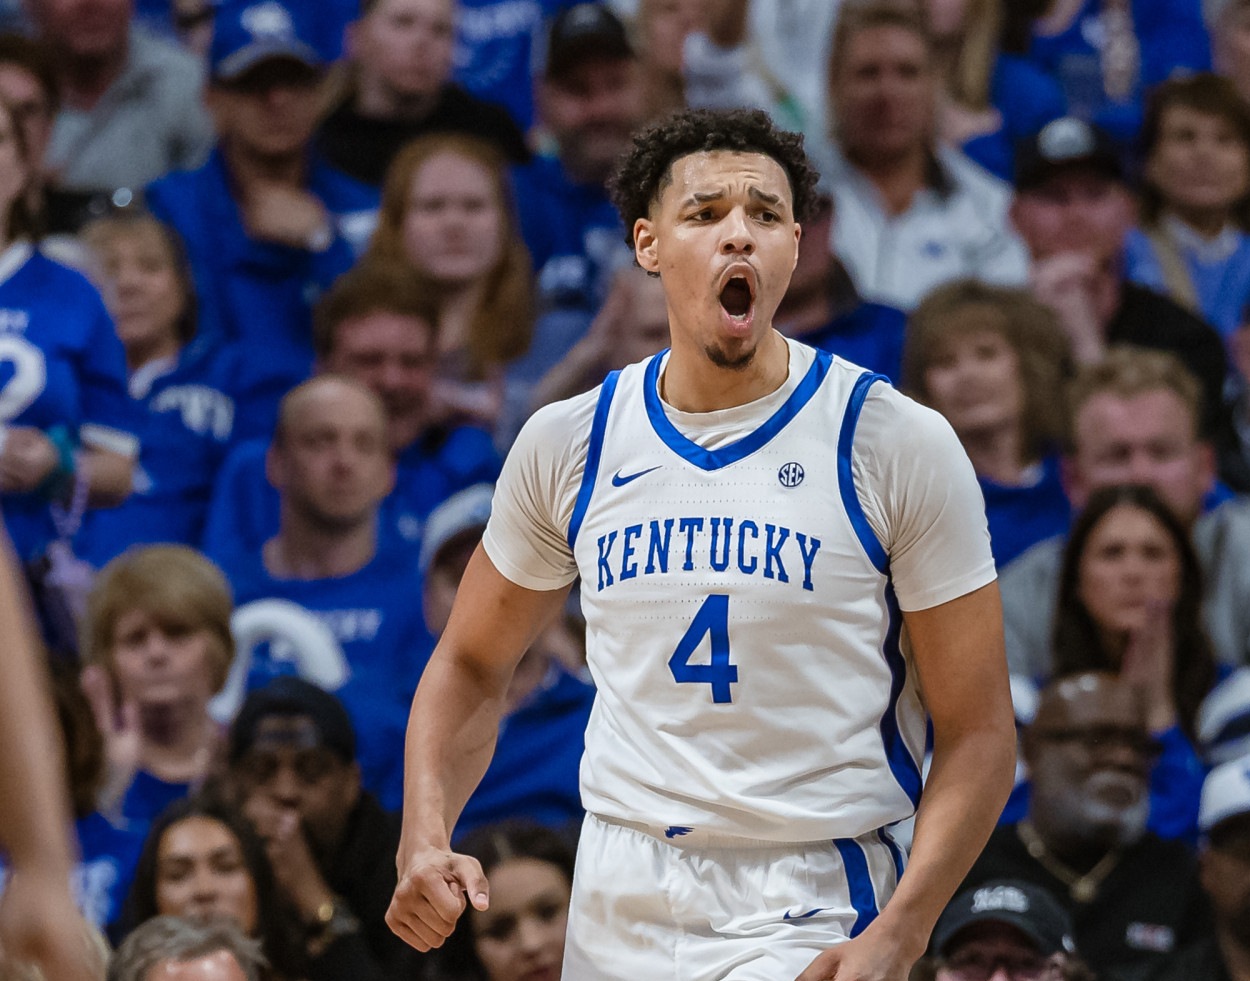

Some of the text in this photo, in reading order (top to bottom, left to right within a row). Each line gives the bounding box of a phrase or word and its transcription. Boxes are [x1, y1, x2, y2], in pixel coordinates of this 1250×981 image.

[778, 462, 804, 487] SEC
[597, 517, 821, 592] KENTUCKY
[668, 594, 738, 704] 4
